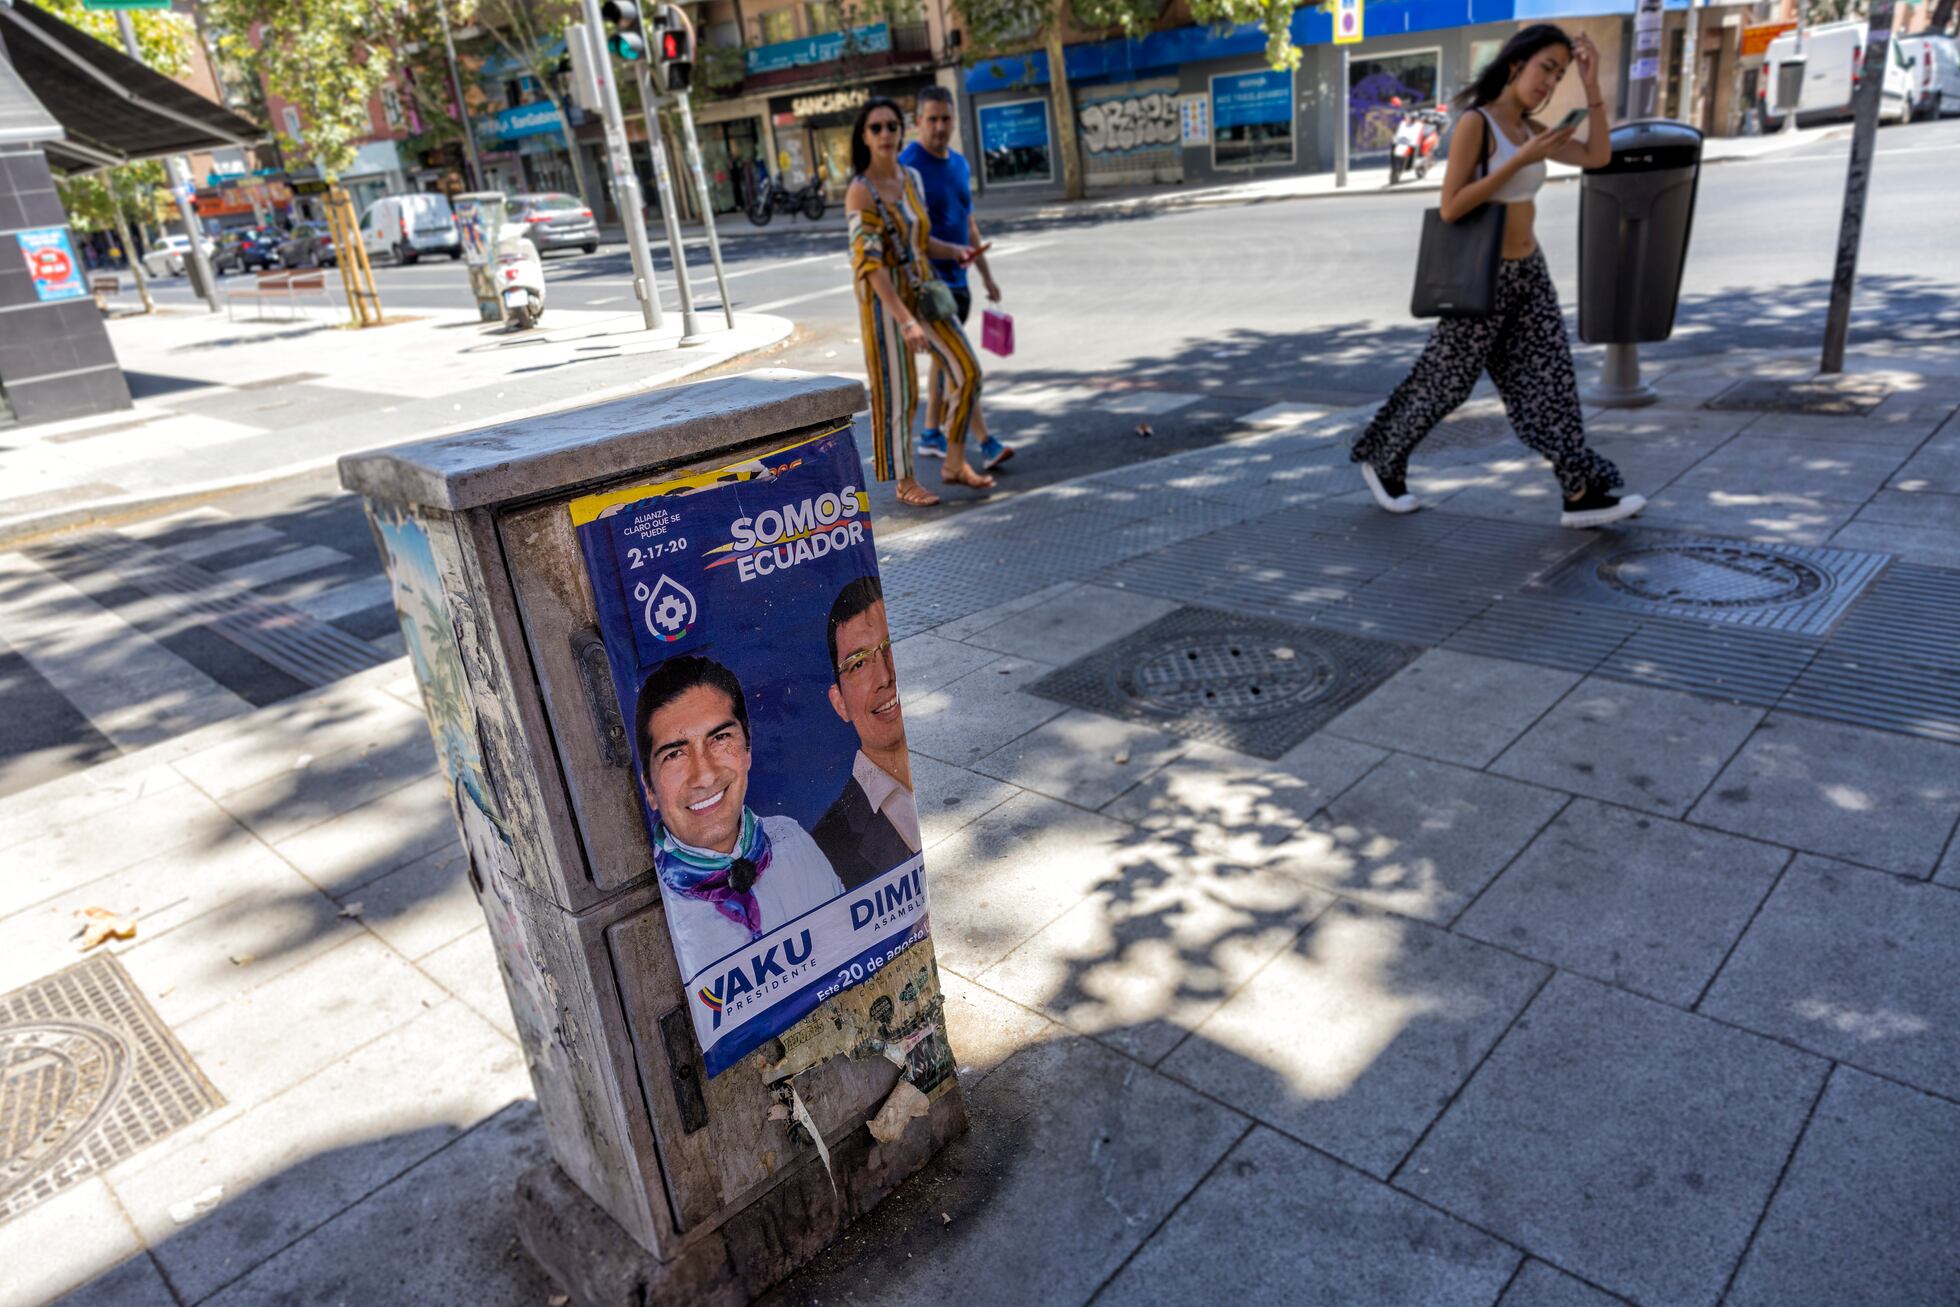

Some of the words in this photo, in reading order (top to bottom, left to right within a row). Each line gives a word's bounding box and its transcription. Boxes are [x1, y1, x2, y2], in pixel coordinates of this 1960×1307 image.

[623, 522, 651, 537] CLARO
[652, 519, 672, 531] QUE
[670, 514, 681, 523] SE
[634, 509, 668, 524] ALIANZA
[640, 526, 668, 540] PUEDE
[730, 485, 861, 553] SOMOS
[627, 537, 688, 570] 2-17-20
[736, 521, 865, 583] ECUADOR
[699, 928, 813, 1031] YAKU
[727, 957, 818, 1016] PRESIDENTE
[816, 982, 841, 1002] Este
[838, 962, 865, 987] 20
[867, 956, 885, 972] de
